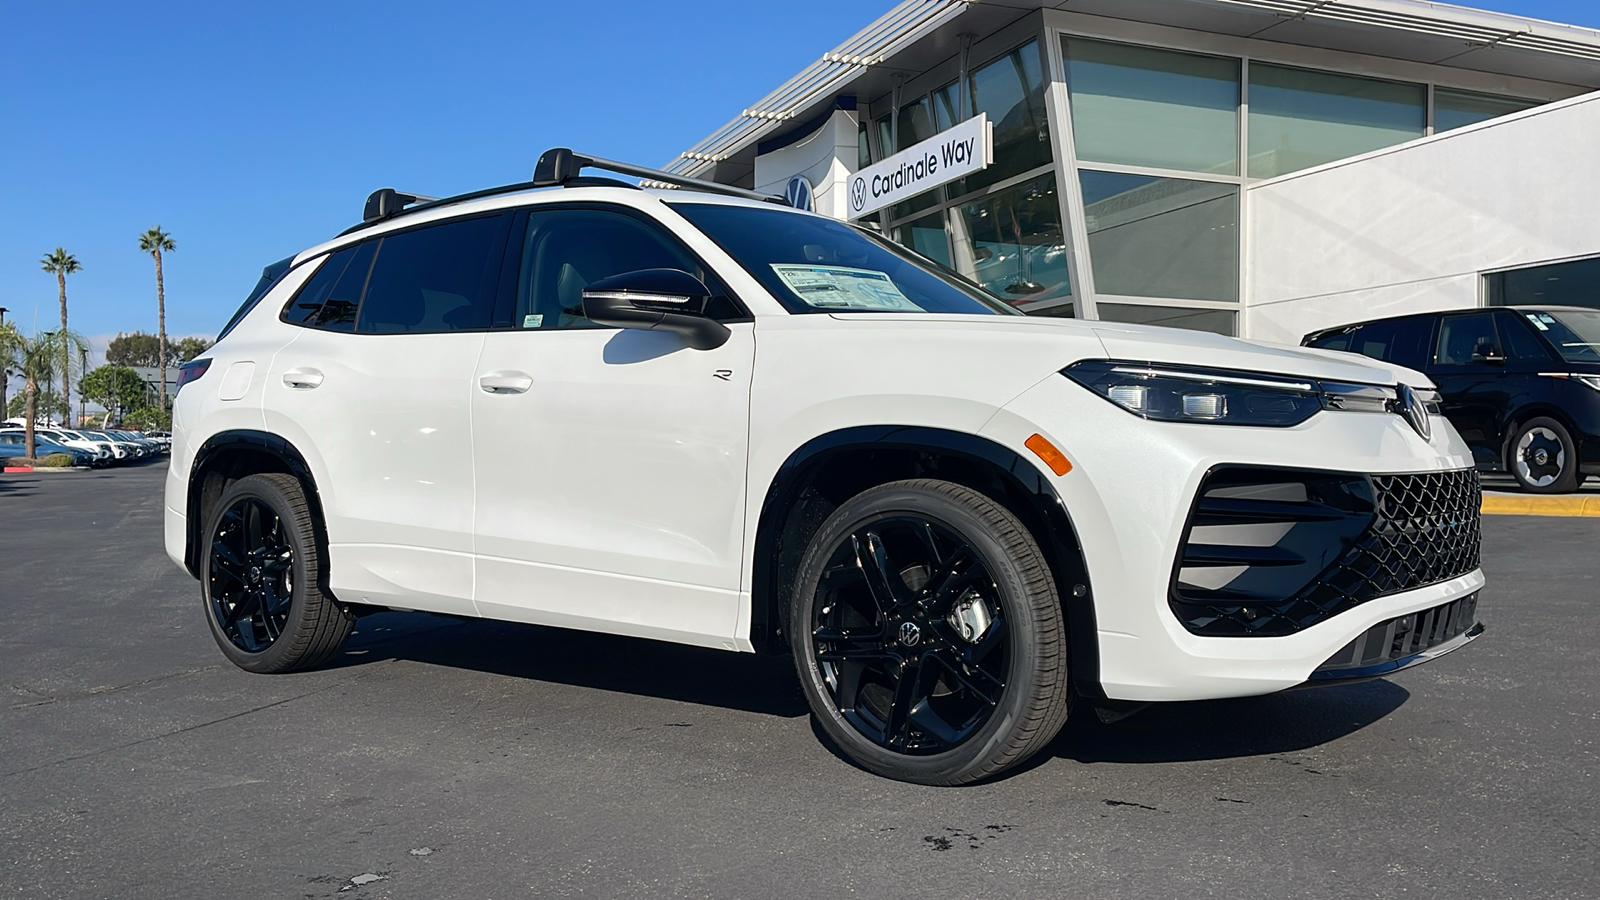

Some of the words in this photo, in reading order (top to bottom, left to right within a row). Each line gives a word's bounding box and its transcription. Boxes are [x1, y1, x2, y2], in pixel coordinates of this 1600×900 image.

[872, 153, 937, 198] Cardinale
[941, 137, 974, 168] Way
[821, 511, 849, 542] ZERO
